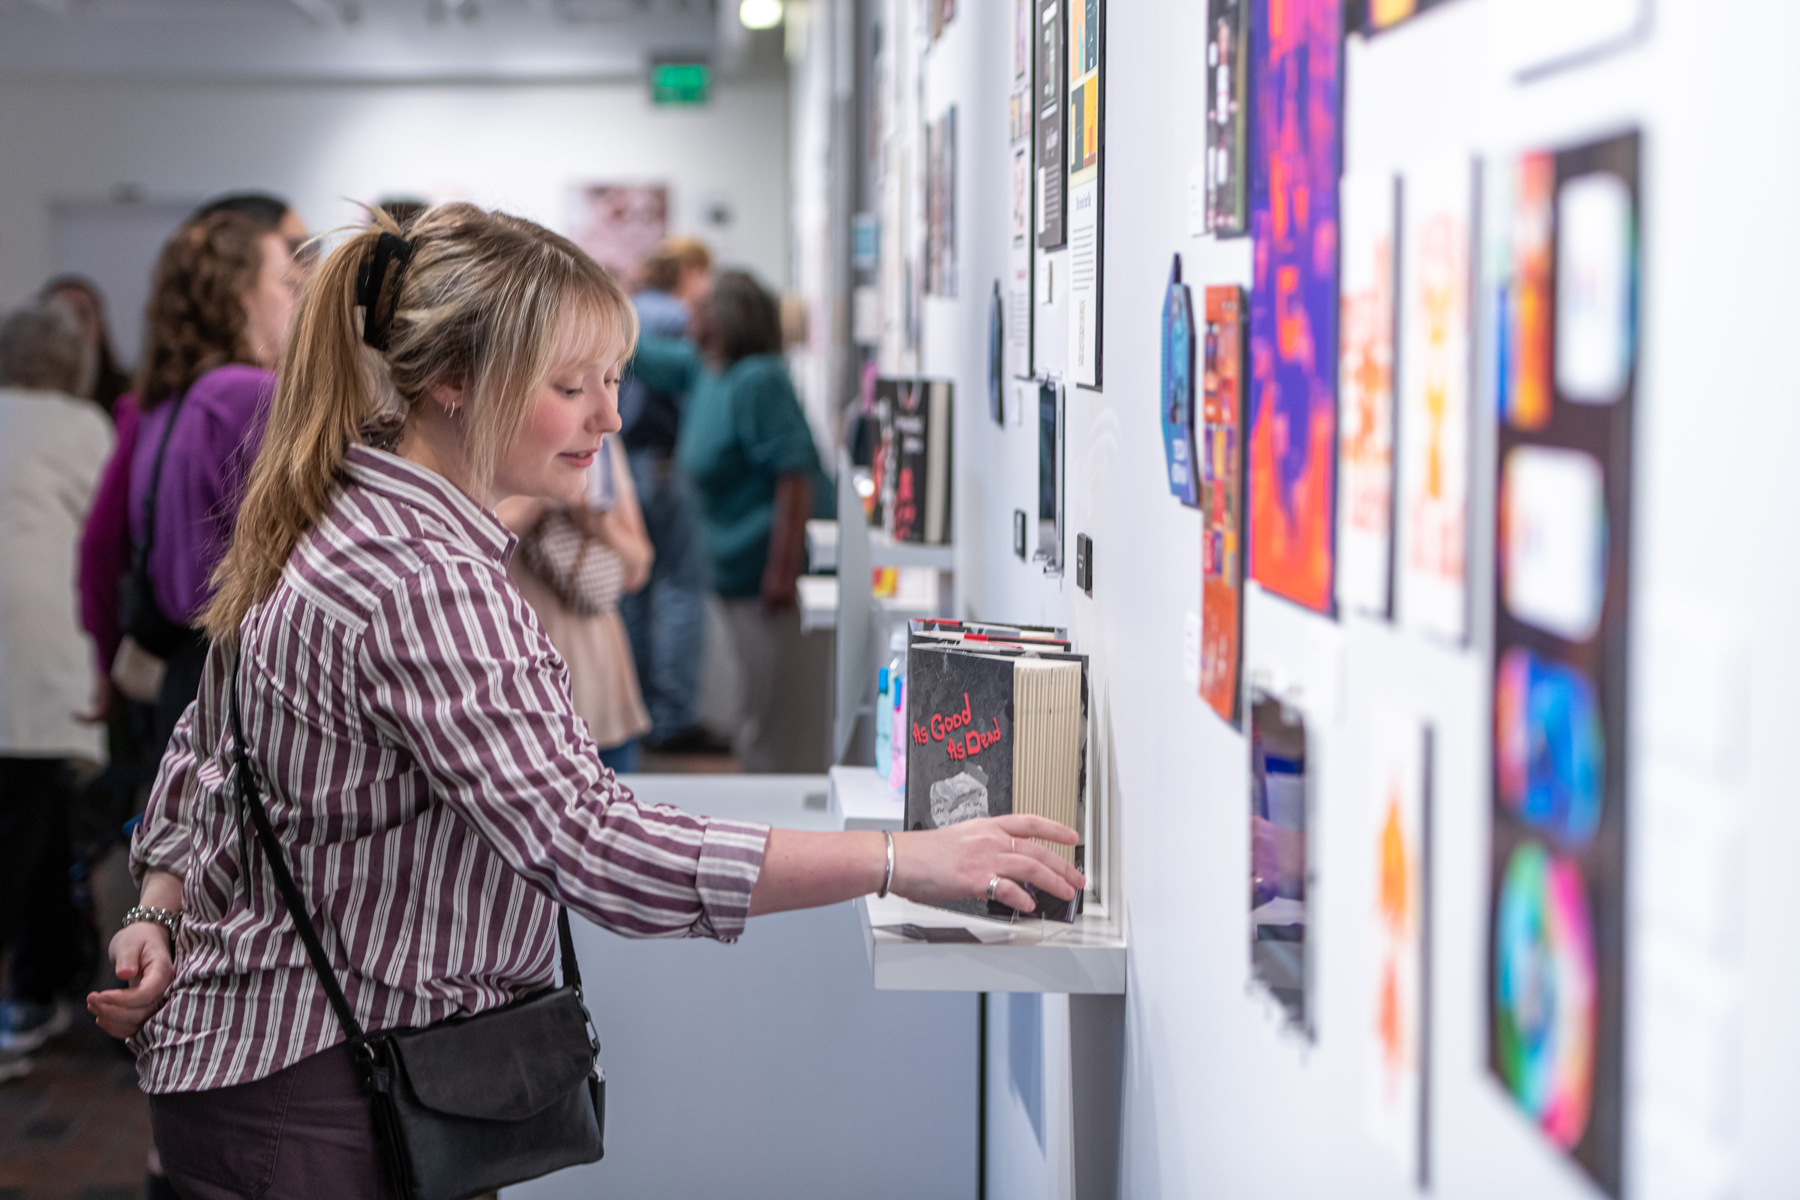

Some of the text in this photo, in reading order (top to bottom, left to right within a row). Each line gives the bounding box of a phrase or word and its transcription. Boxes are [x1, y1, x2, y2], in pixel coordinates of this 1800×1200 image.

[912, 692, 971, 744] As Good
[947, 717, 1001, 759] As Dead
